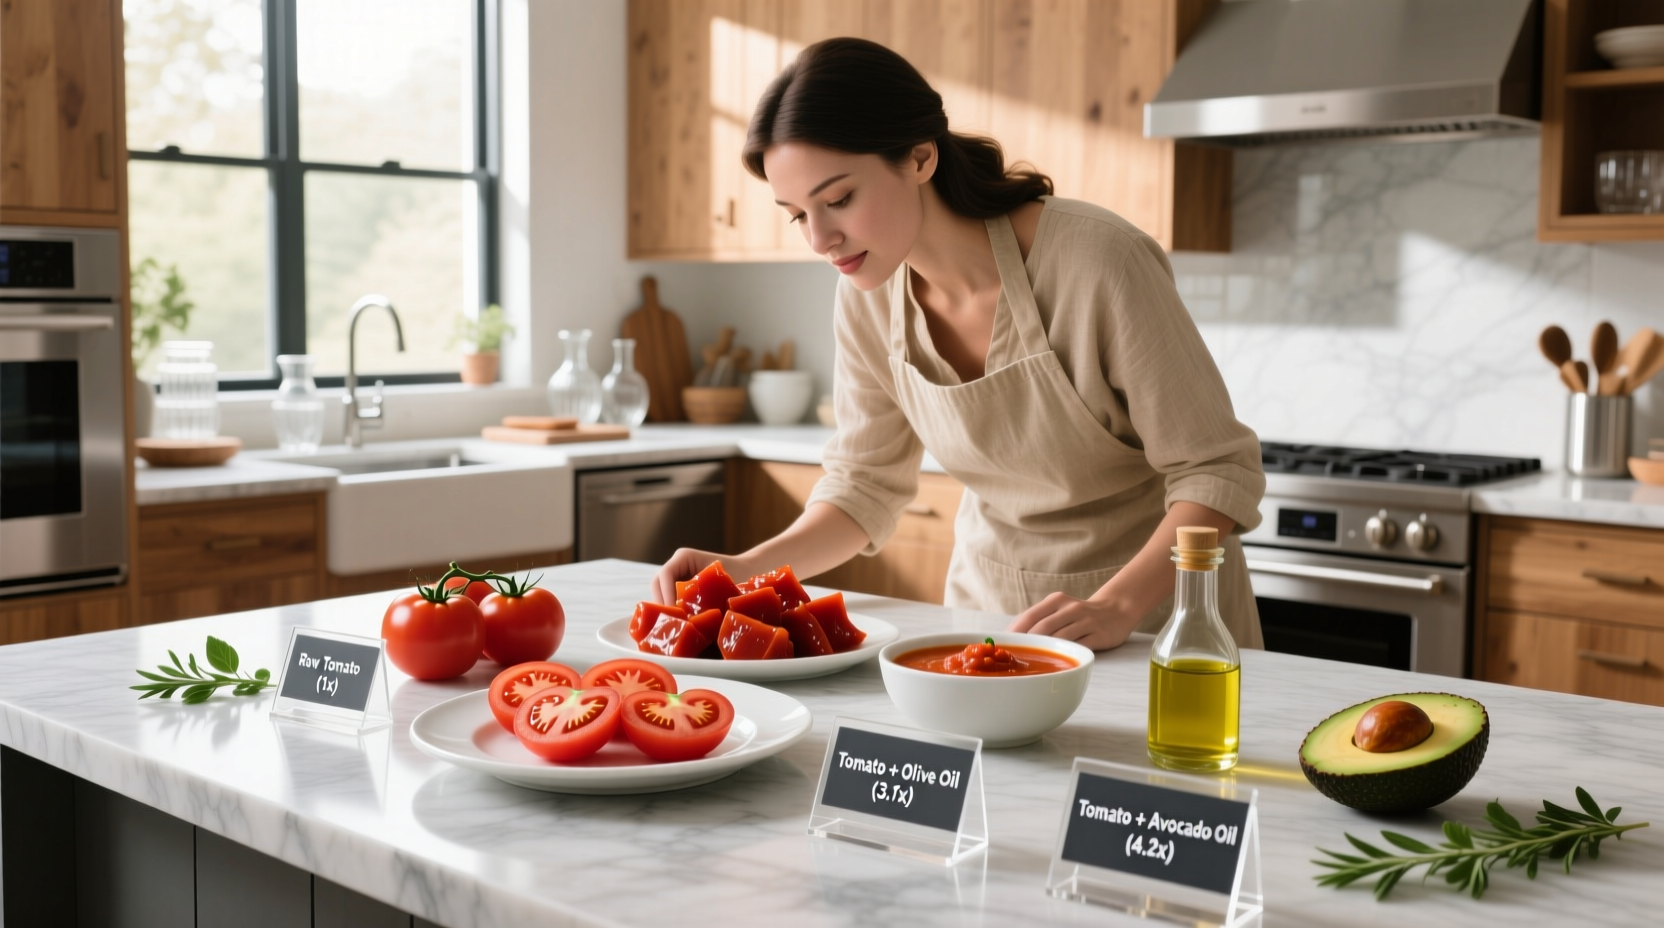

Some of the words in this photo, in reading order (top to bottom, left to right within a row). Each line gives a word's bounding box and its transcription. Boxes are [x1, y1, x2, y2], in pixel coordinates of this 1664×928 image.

[299, 652, 320, 669] Raw
[316, 675, 338, 697] (1x)
[839, 751, 886, 776] Tomato
[888, 764, 899, 777] +
[901, 763, 937, 785] Olive
[939, 769, 961, 789] Oil
[1079, 799, 1132, 826] Tomato
[1135, 812, 1147, 826] +
[1147, 811, 1213, 841] Avocado
[1214, 823, 1239, 846] Oil
[1125, 833, 1175, 866] (4.2x)
